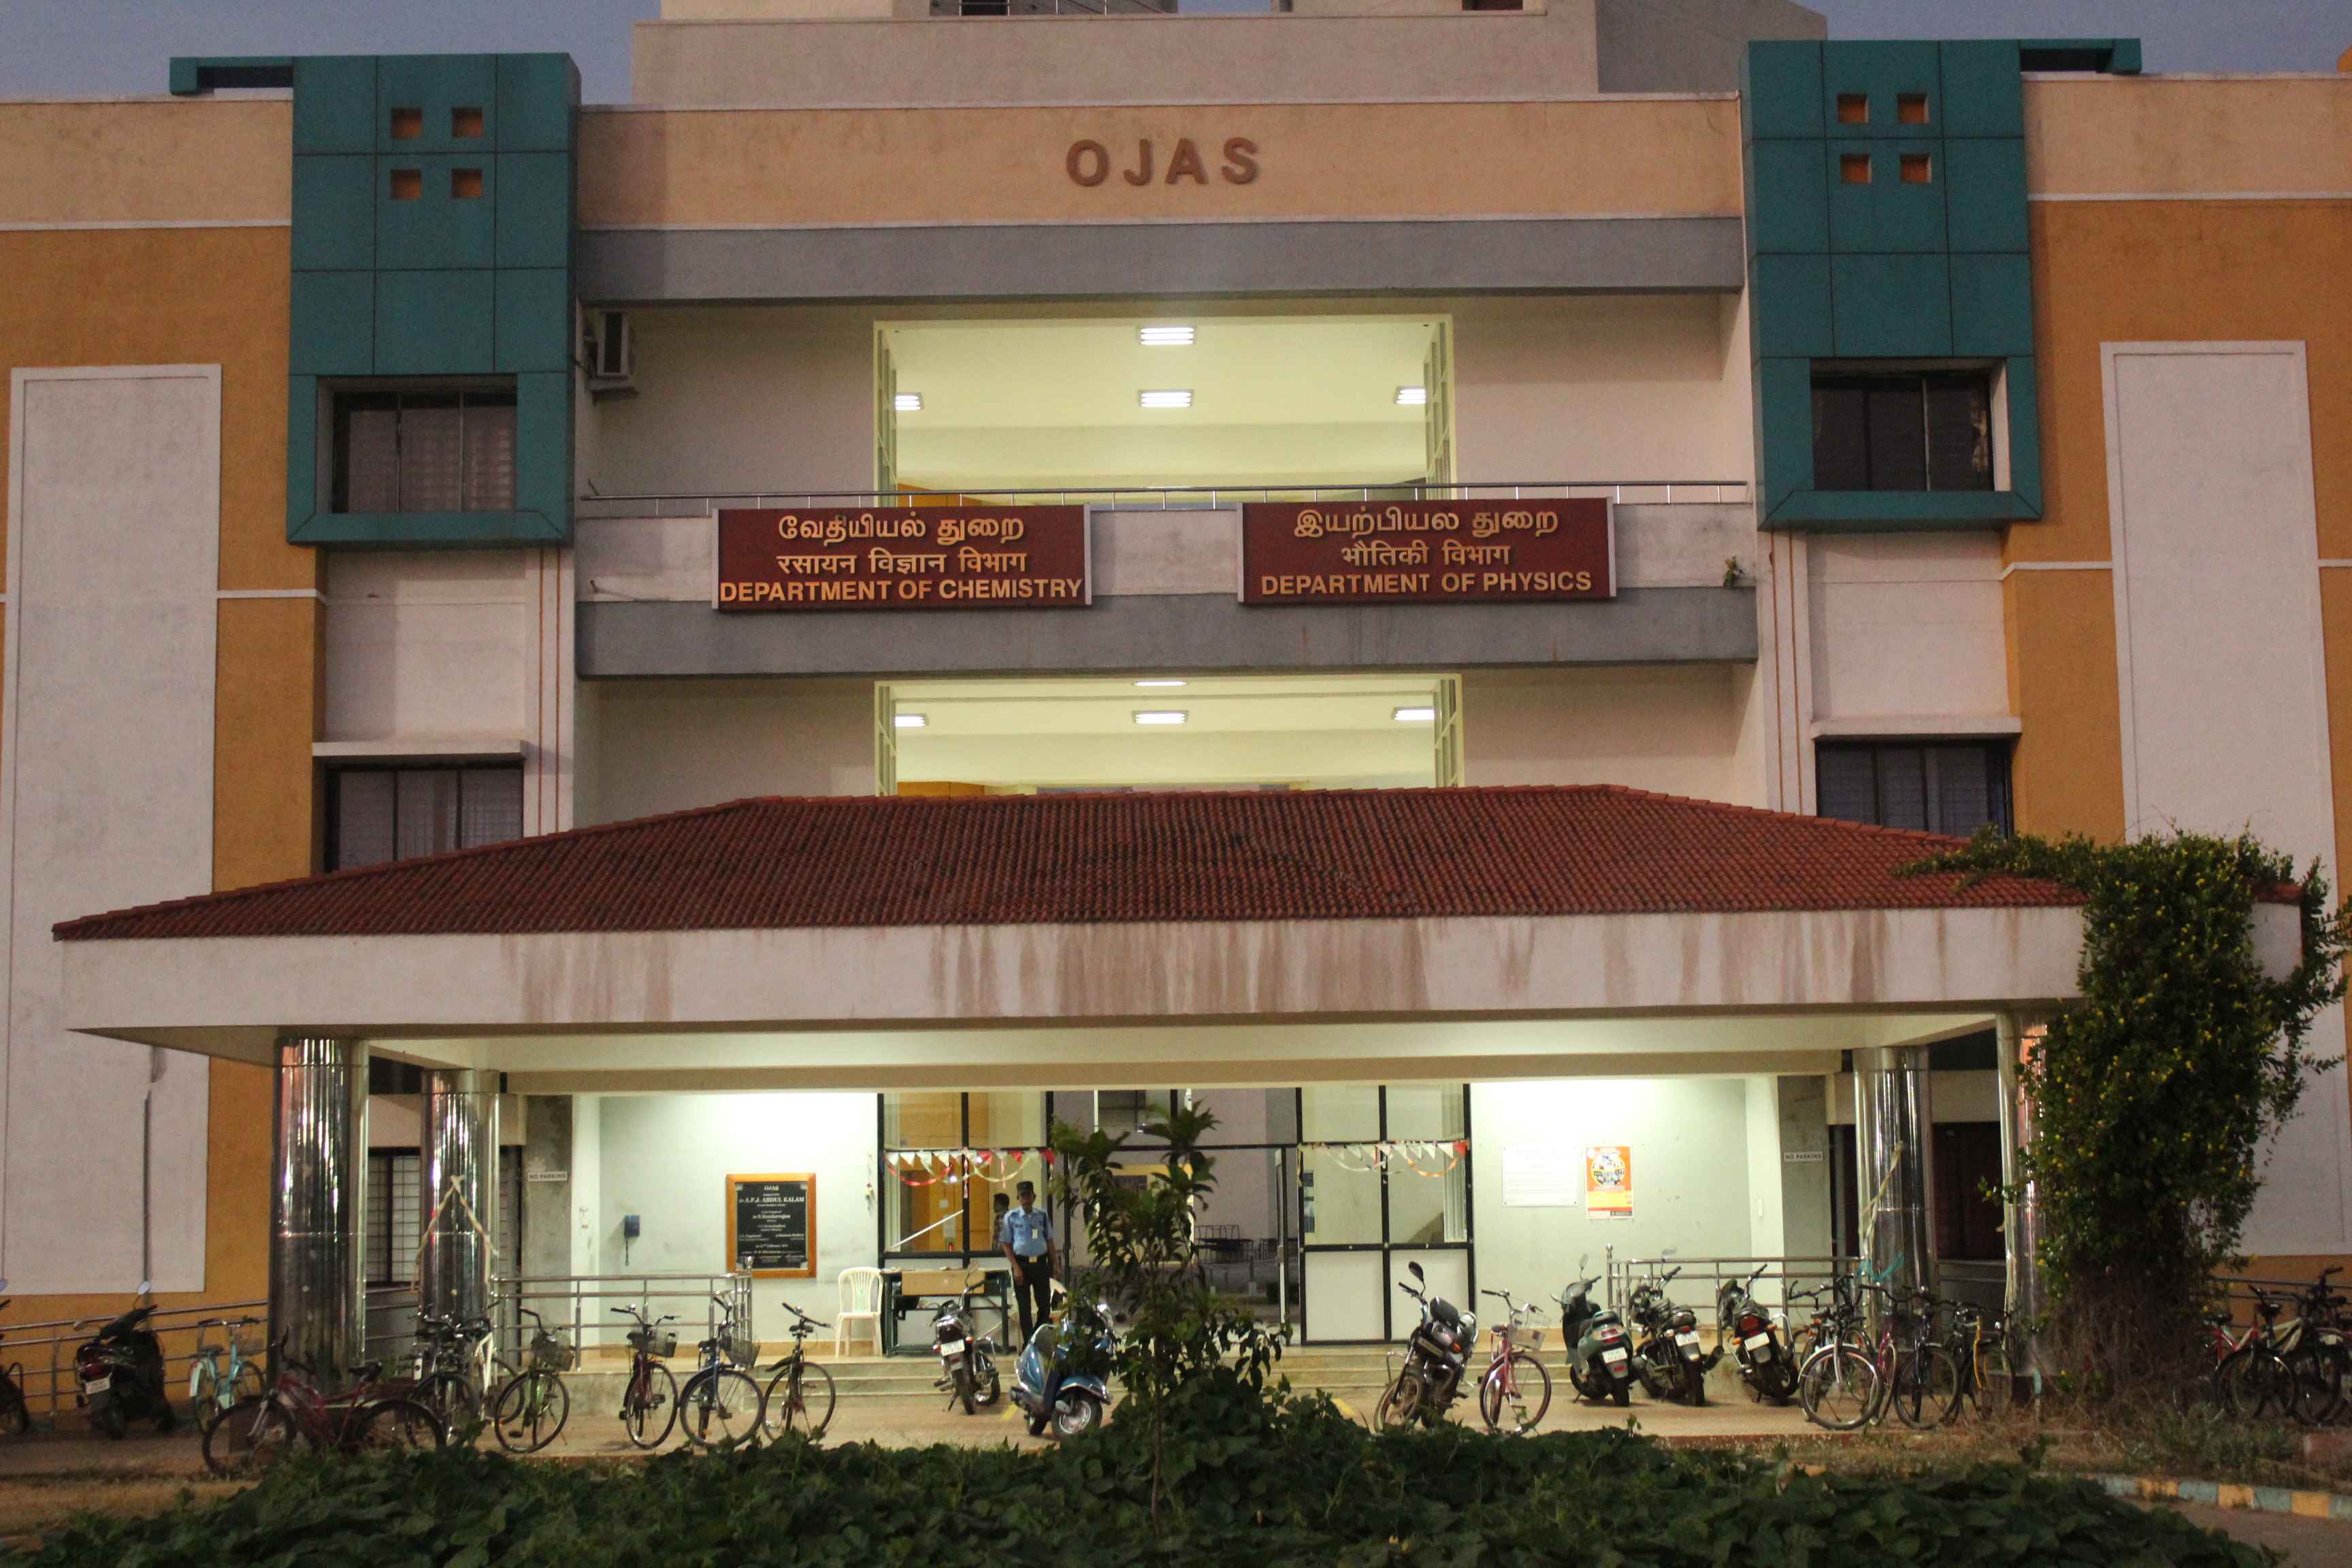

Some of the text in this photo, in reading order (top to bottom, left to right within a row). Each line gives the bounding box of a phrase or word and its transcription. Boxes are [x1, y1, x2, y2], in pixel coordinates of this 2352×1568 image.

[1066, 137, 1259, 186] OJAS
[937, 518, 1024, 545] துறை
[1472, 511, 1558, 538] துறை
[776, 546, 1028, 575] रसायन विज्ञान विभाग
[1341, 538, 1511, 566] भौतिकी विभाग
[720, 578, 1082, 602] DEPARTMENT OF CHEMISTRY
[1262, 571, 1592, 595] DEPARTMENT OF PHYSICS
